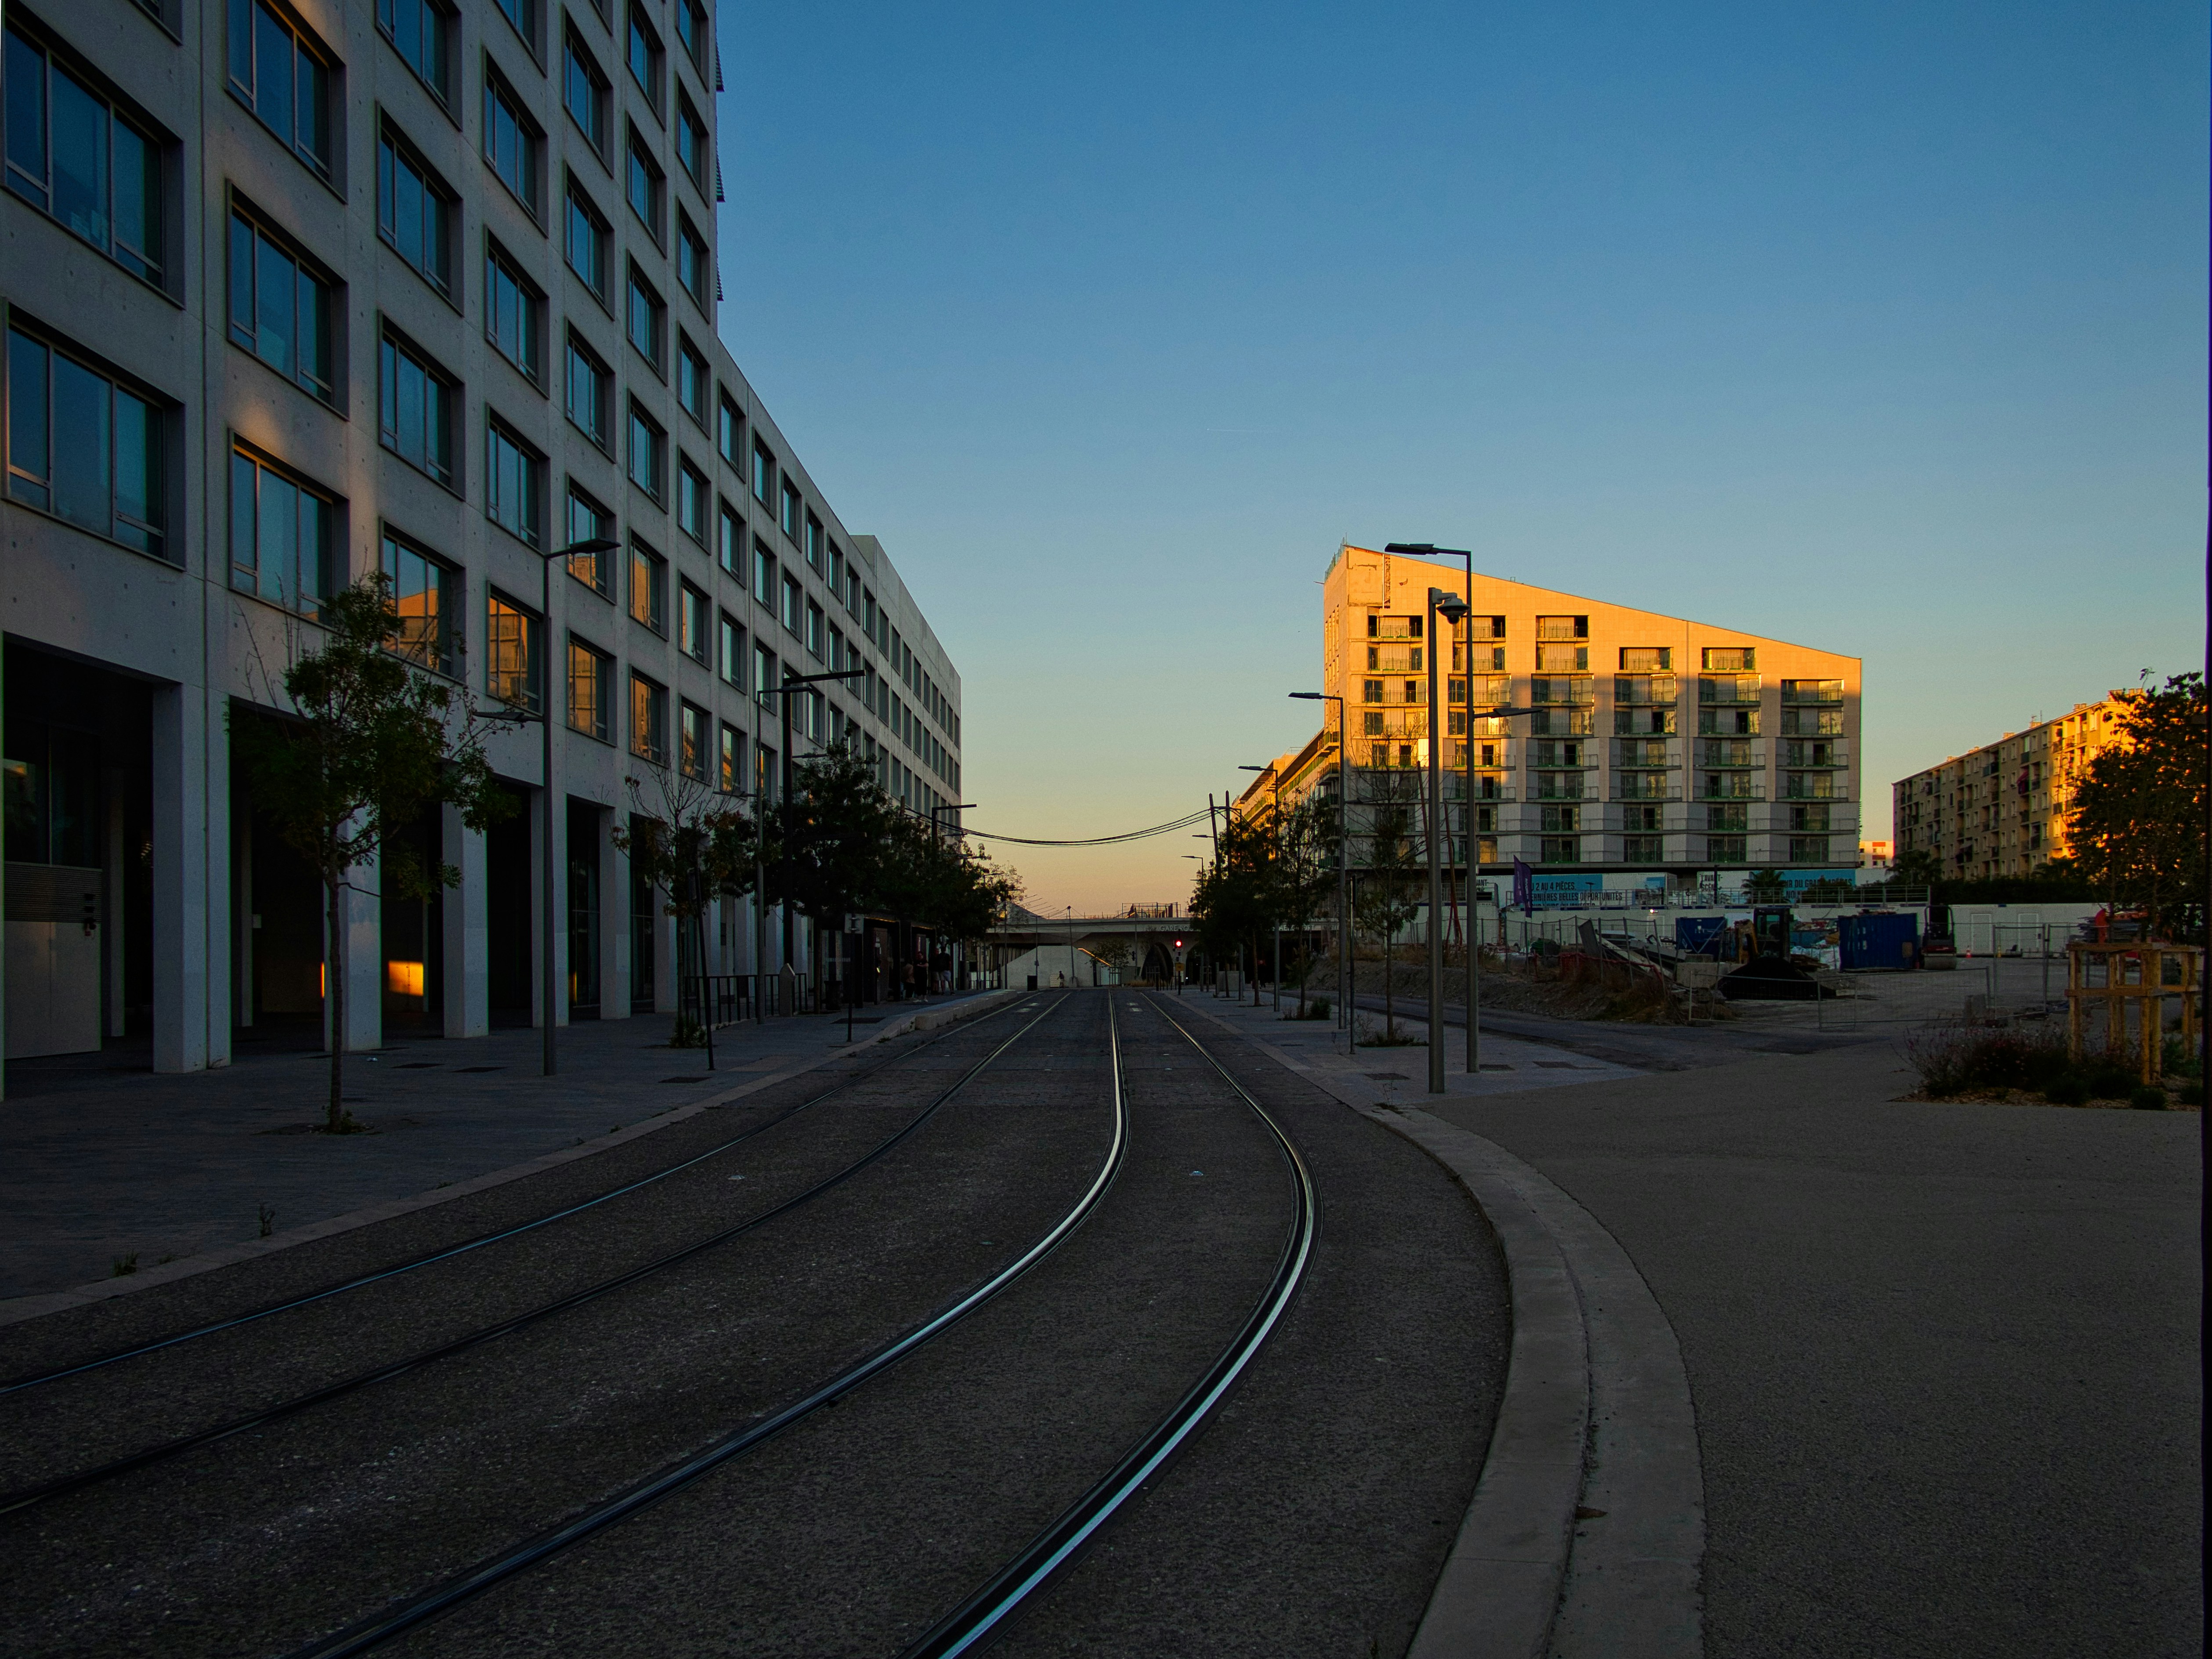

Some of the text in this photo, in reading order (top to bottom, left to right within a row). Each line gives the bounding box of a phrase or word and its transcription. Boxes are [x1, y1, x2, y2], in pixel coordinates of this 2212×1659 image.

[1536, 882, 1540, 891] 2
[1541, 882, 1548, 891] AU
[1550, 882, 1554, 890] 4
[1795, 879, 1803, 888] DU
[1559, 892, 1579, 901] BELLES
[1580, 891, 1623, 900] OPPORTUNITÉS
